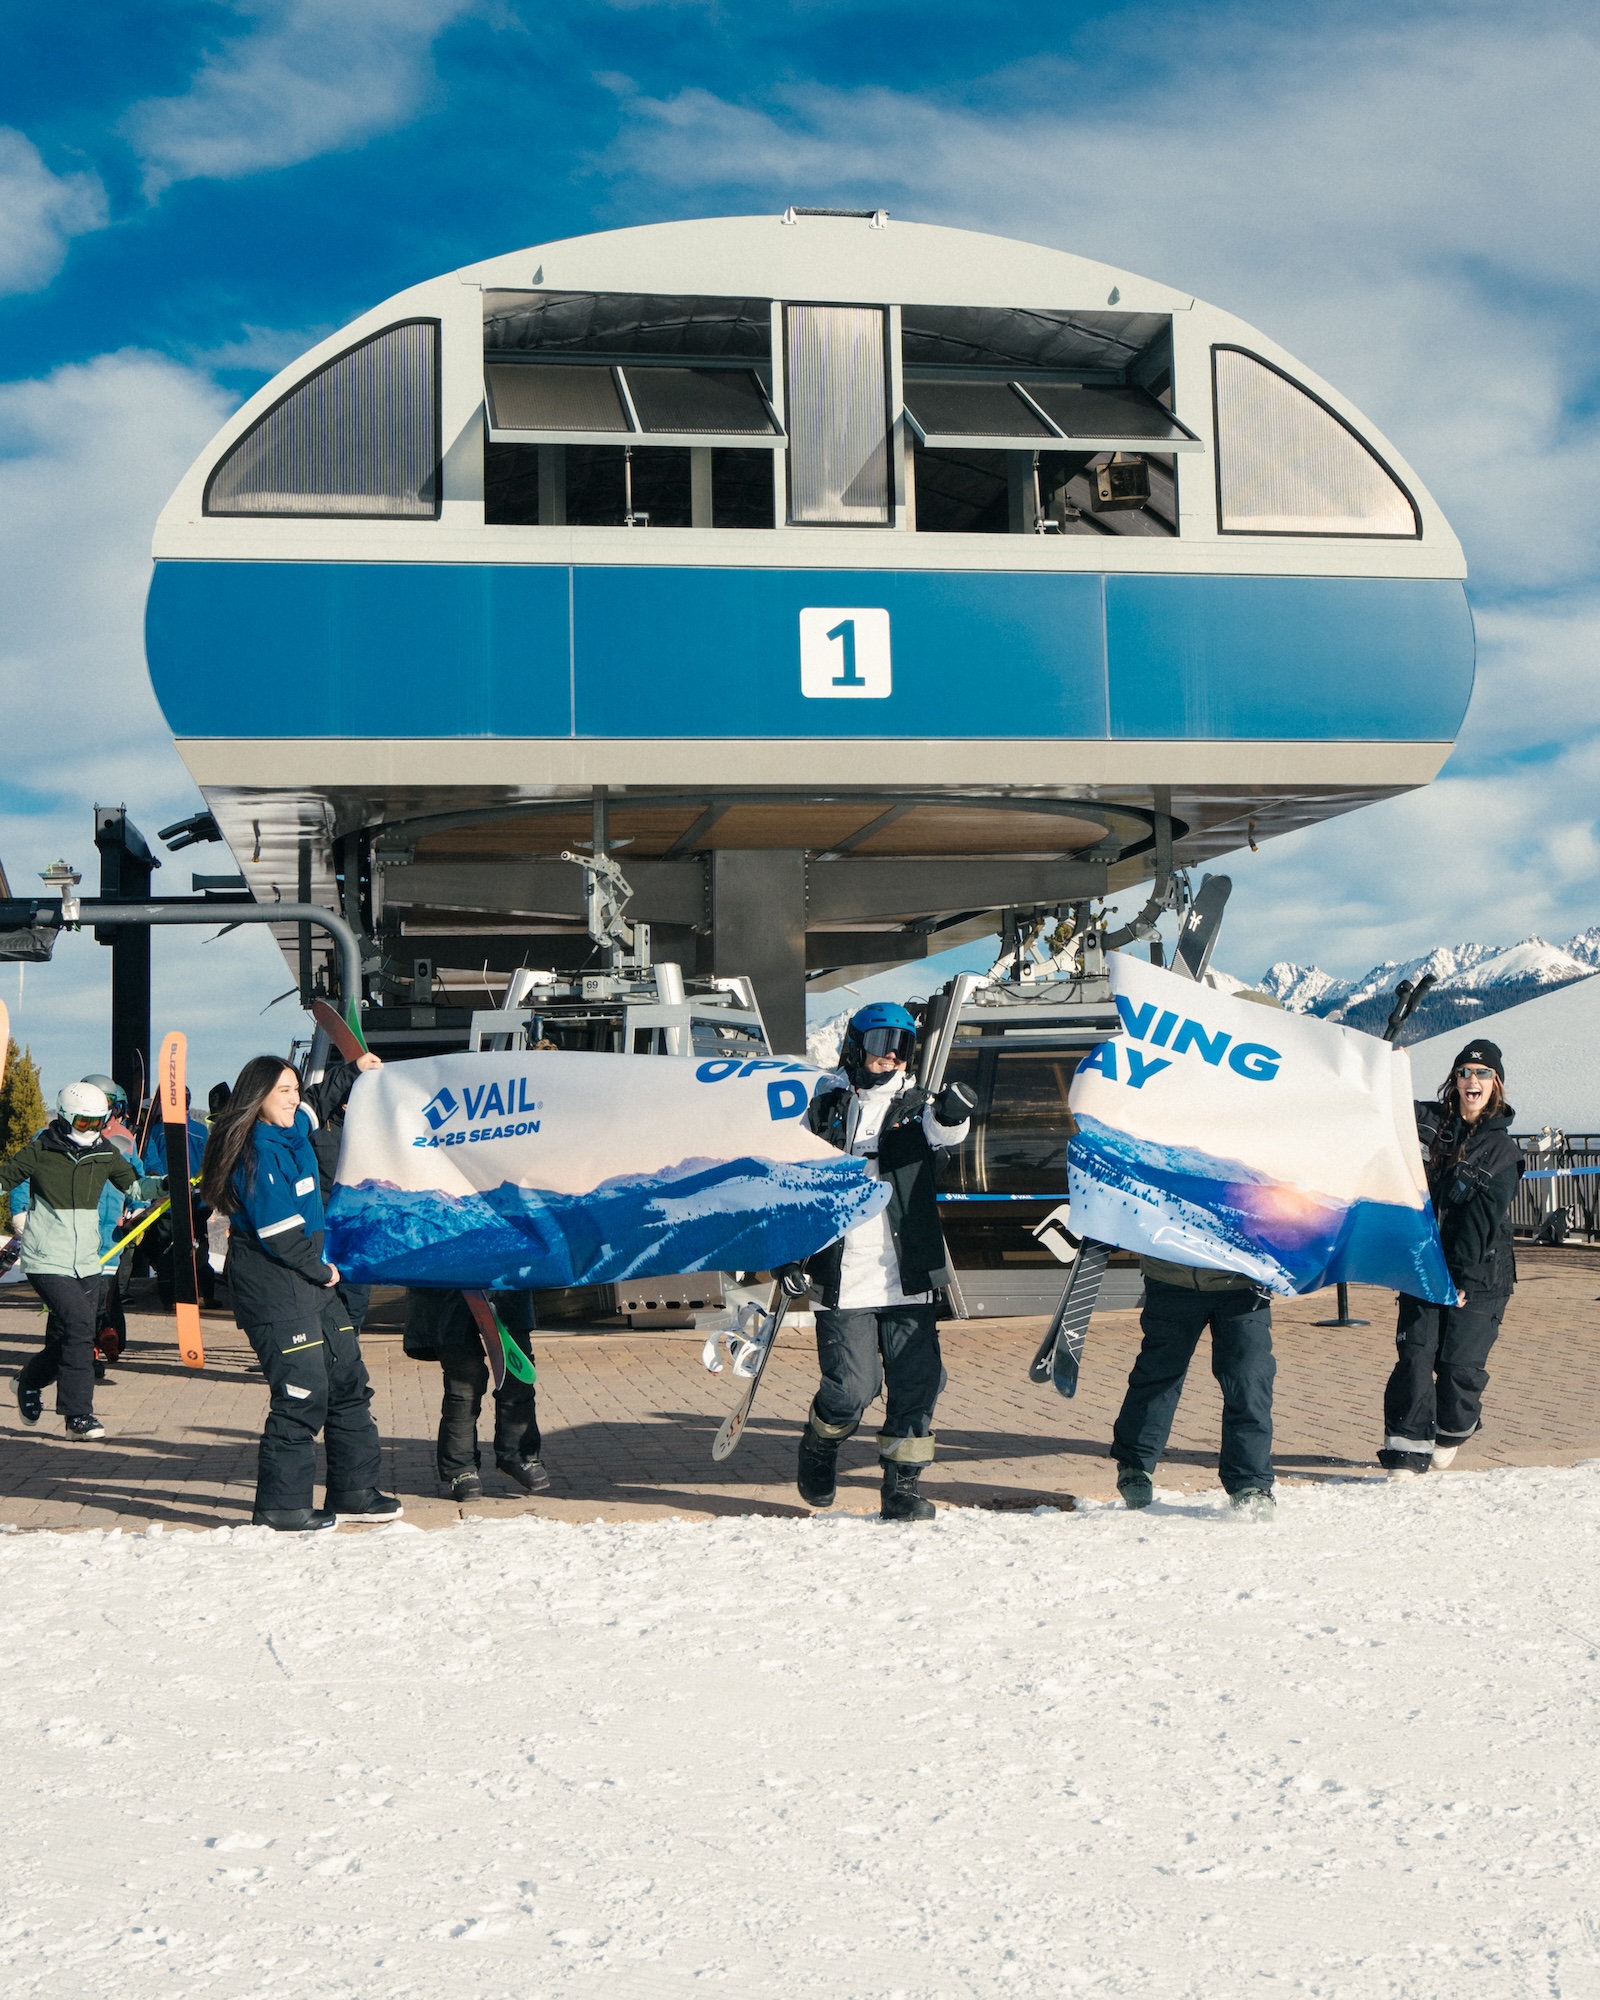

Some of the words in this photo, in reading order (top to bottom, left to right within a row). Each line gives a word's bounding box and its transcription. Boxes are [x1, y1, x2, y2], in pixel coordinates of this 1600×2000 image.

[826, 619, 866, 687] 1
[586, 980, 599, 990] 69
[169, 1042, 178, 1107] BLIZZARD
[462, 1077, 535, 1121] VAIL
[412, 1131, 466, 1148] 24-25
[468, 1120, 541, 1143] SEASON
[292, 1332, 307, 1345] HH
